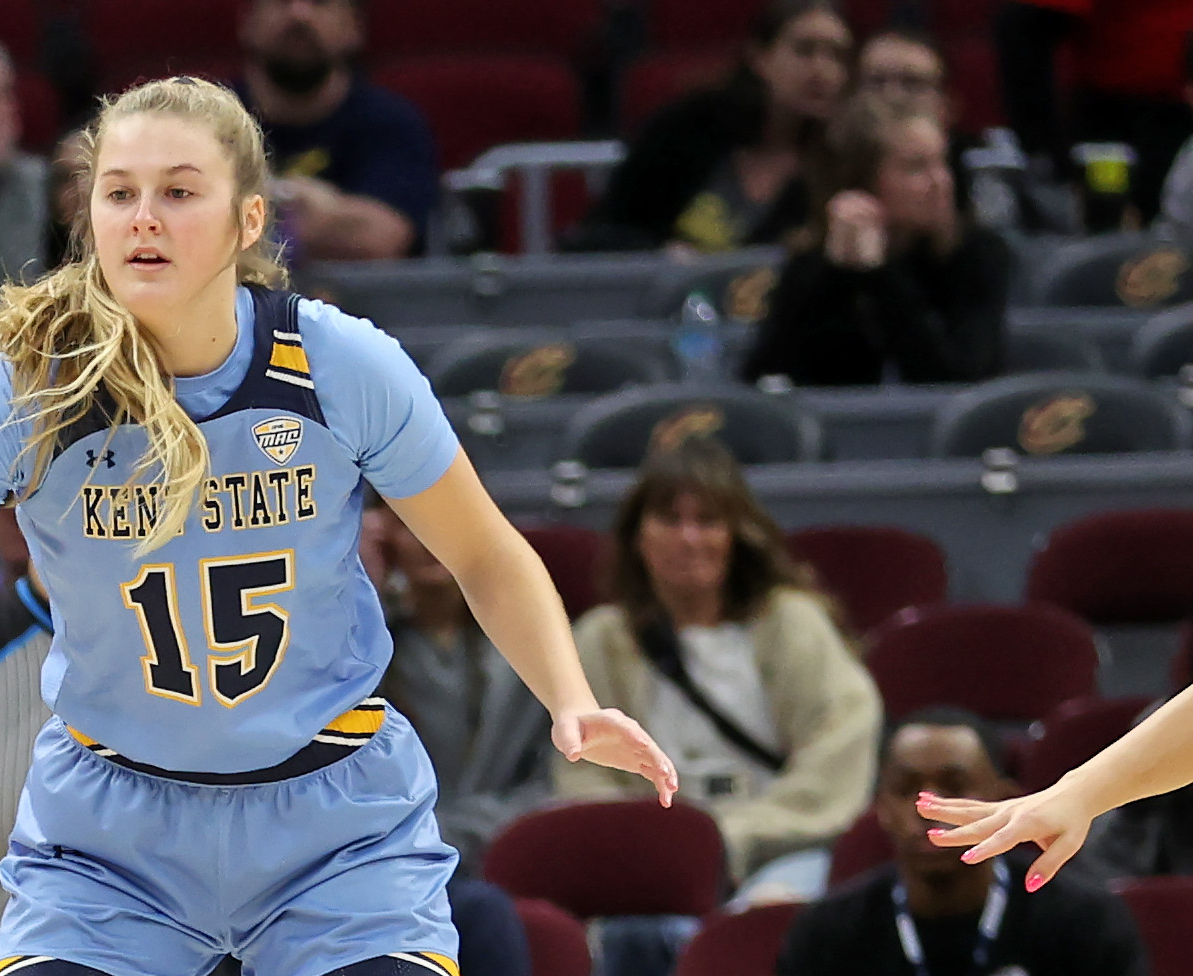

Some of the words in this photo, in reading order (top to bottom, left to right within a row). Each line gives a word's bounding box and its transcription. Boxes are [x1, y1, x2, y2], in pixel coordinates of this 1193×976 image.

[257, 429, 300, 448] MAC
[82, 484, 185, 539] KEN
[202, 464, 318, 532] STATE
[119, 549, 295, 709] 15
